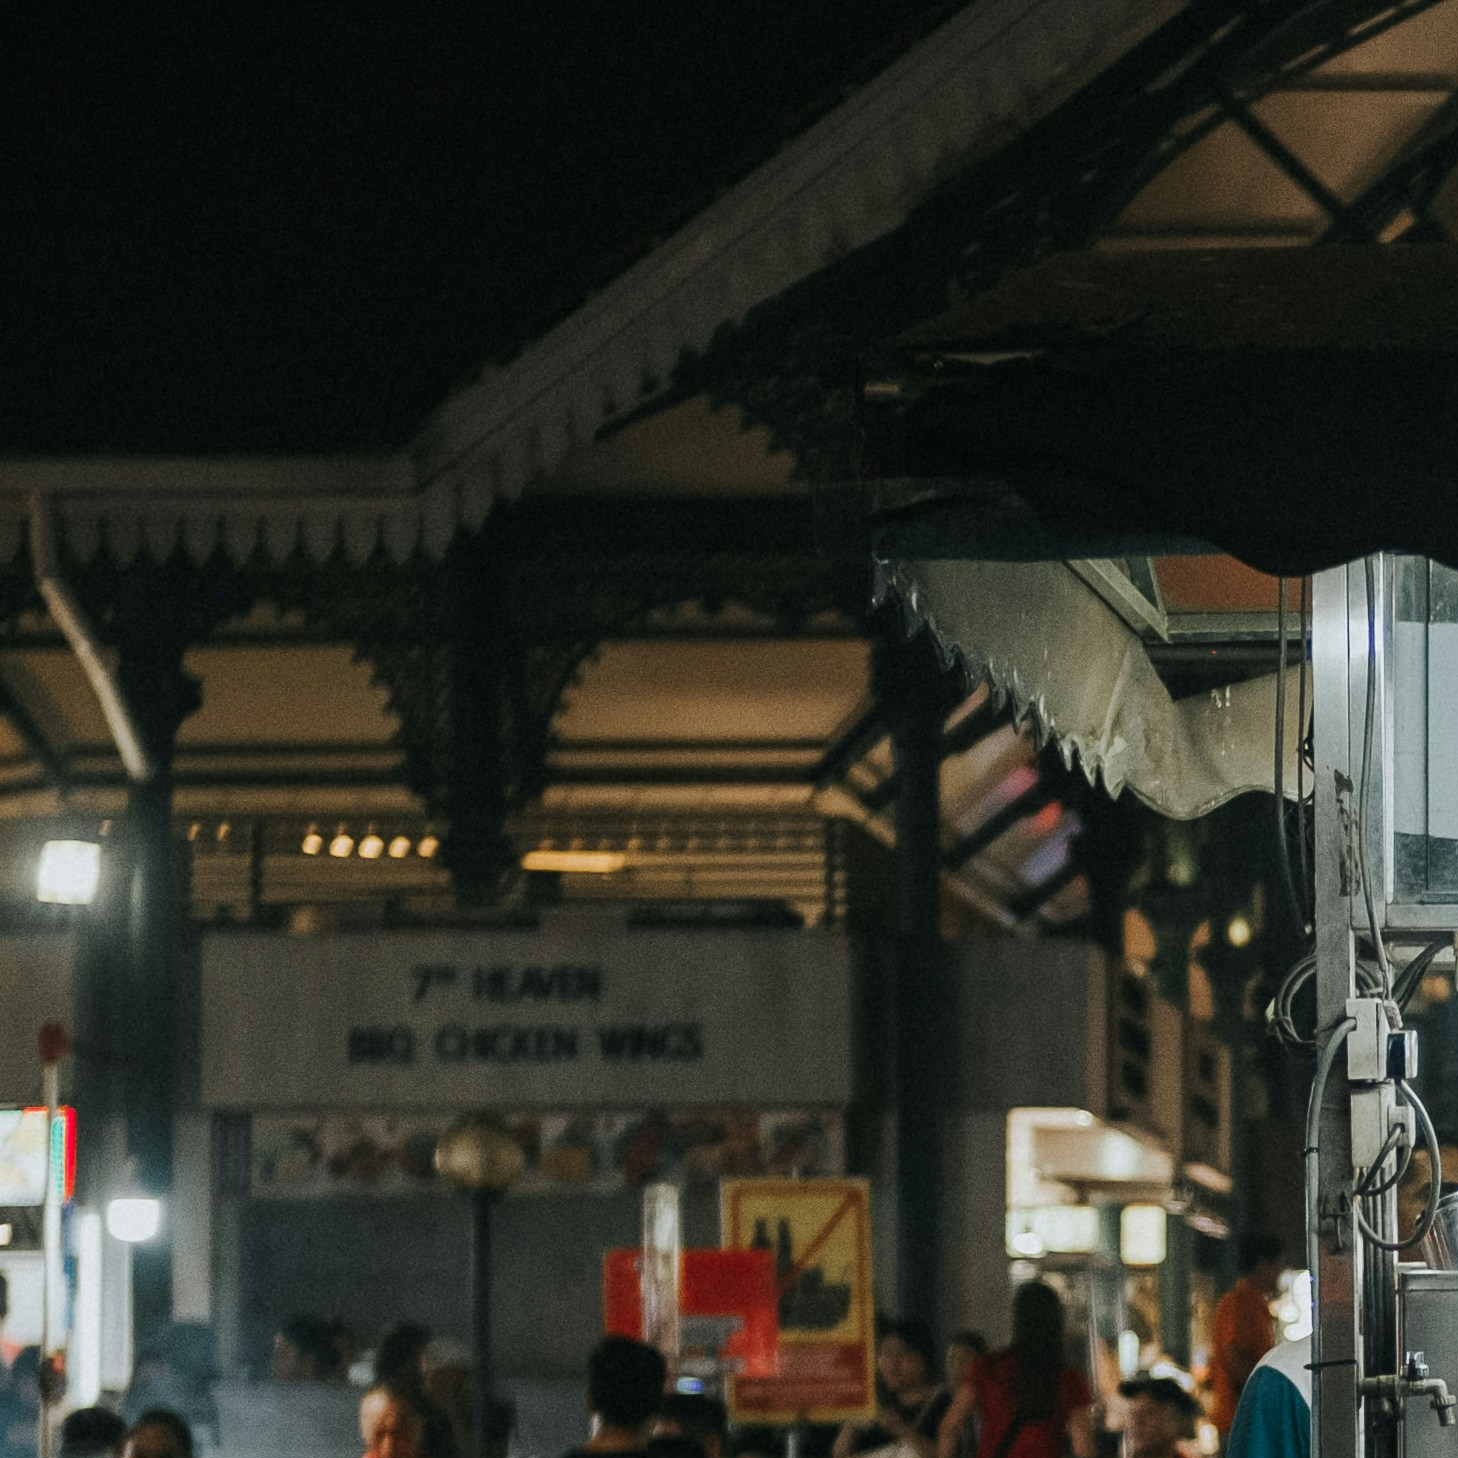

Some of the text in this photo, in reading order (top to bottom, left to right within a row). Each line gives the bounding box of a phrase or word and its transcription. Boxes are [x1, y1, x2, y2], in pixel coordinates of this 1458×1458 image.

[474, 965, 602, 1000] HEAVEN
[348, 1022, 702, 1063] BBQ CHICKEN WINGS
